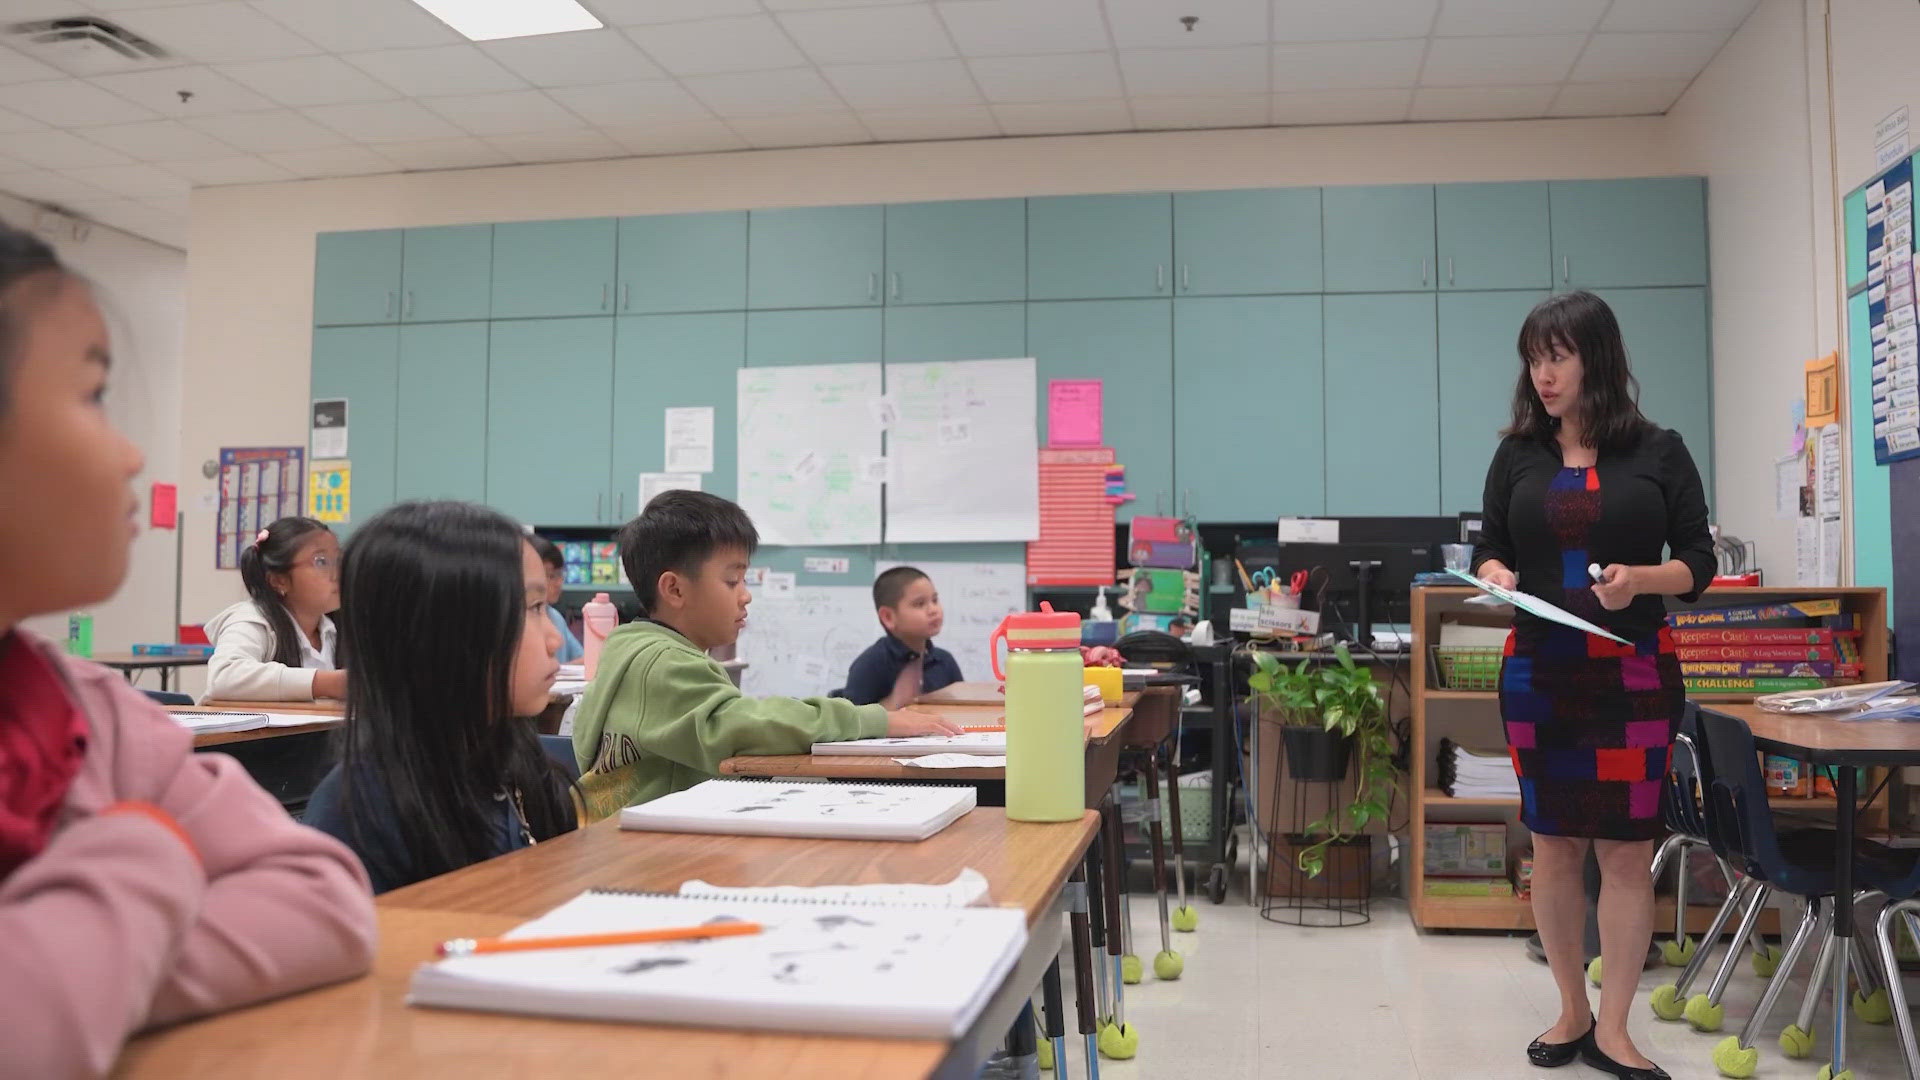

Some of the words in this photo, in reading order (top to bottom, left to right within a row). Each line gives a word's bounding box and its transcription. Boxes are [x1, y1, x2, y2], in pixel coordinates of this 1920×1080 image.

[1260, 617, 1292, 629] scissors
[1680, 631, 1709, 644] Keeper
[1721, 630, 1749, 643] Castle
[1680, 648, 1709, 659] Keeper
[1720, 647, 1748, 659] Castle
[1696, 678, 1755, 688] CHALLENGE
